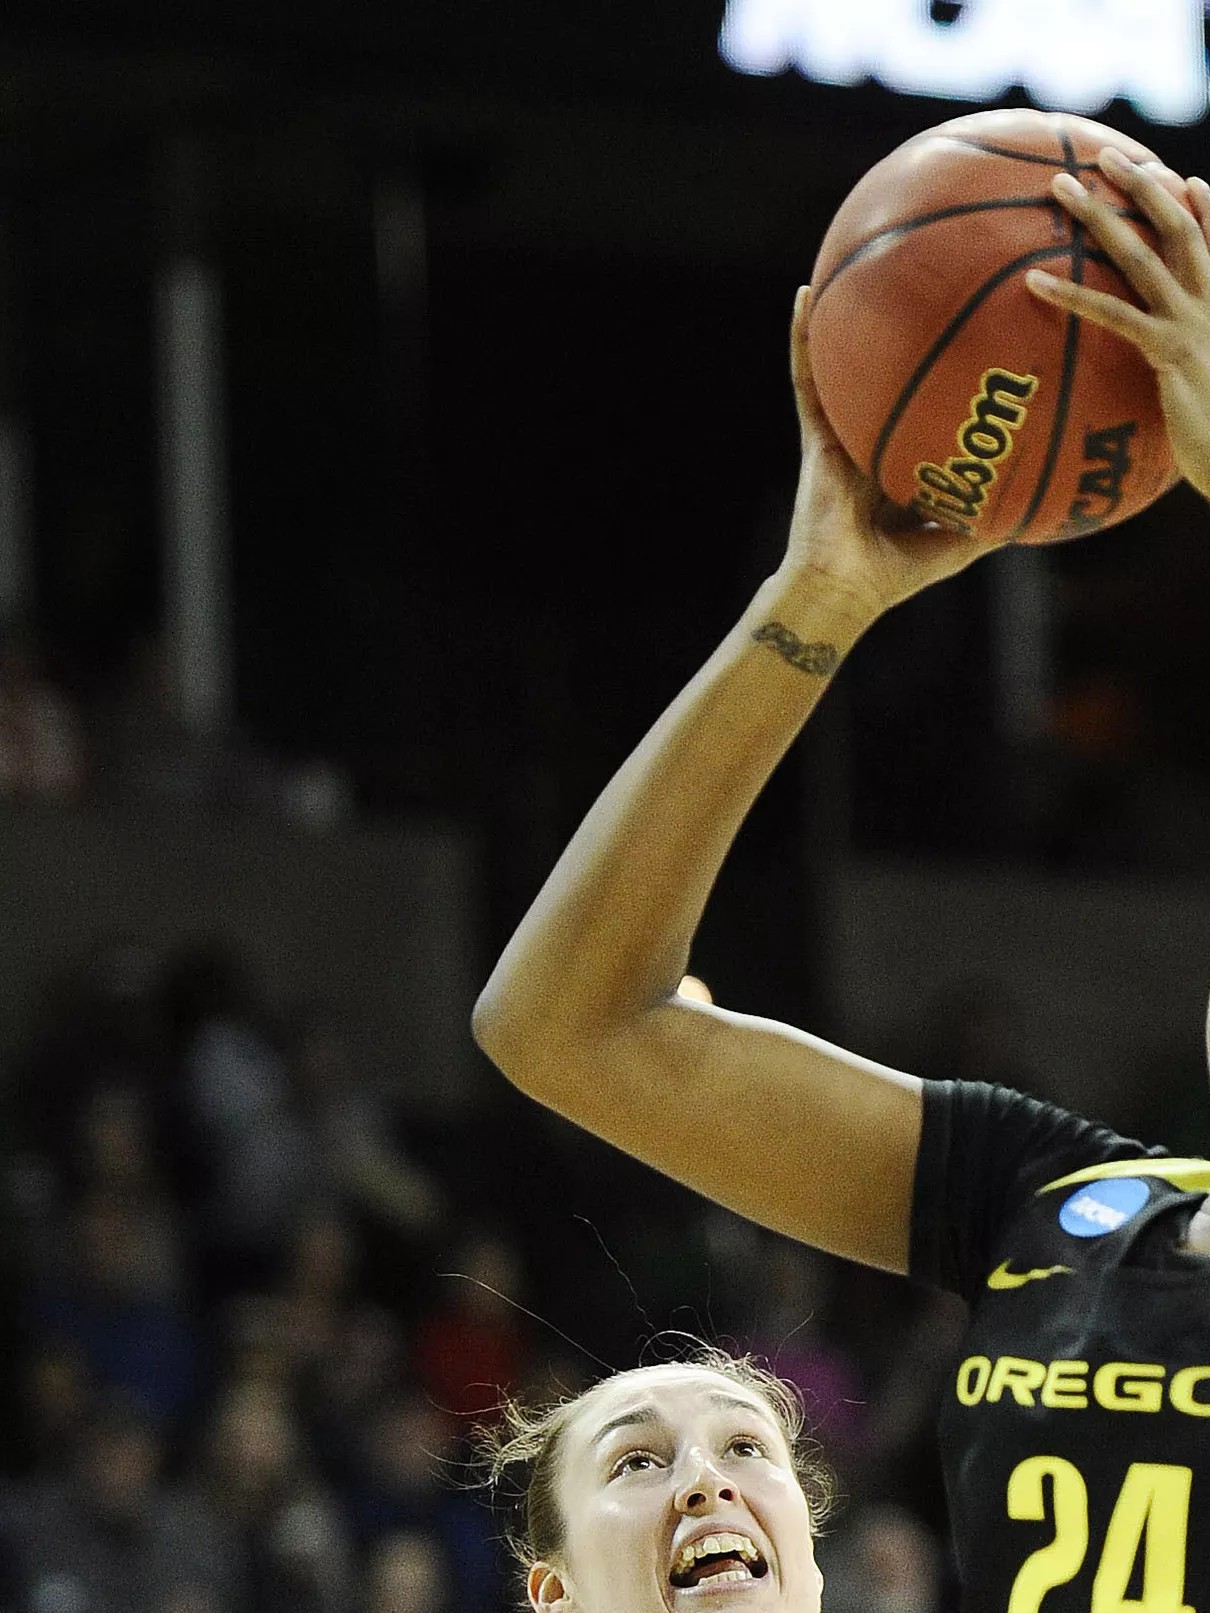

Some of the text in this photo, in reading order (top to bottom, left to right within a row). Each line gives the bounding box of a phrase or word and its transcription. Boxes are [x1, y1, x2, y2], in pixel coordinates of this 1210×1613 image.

[914, 367, 1039, 536] ilson
[1061, 419, 1137, 535] CAA
[1006, 1454, 1196, 1613] 24
